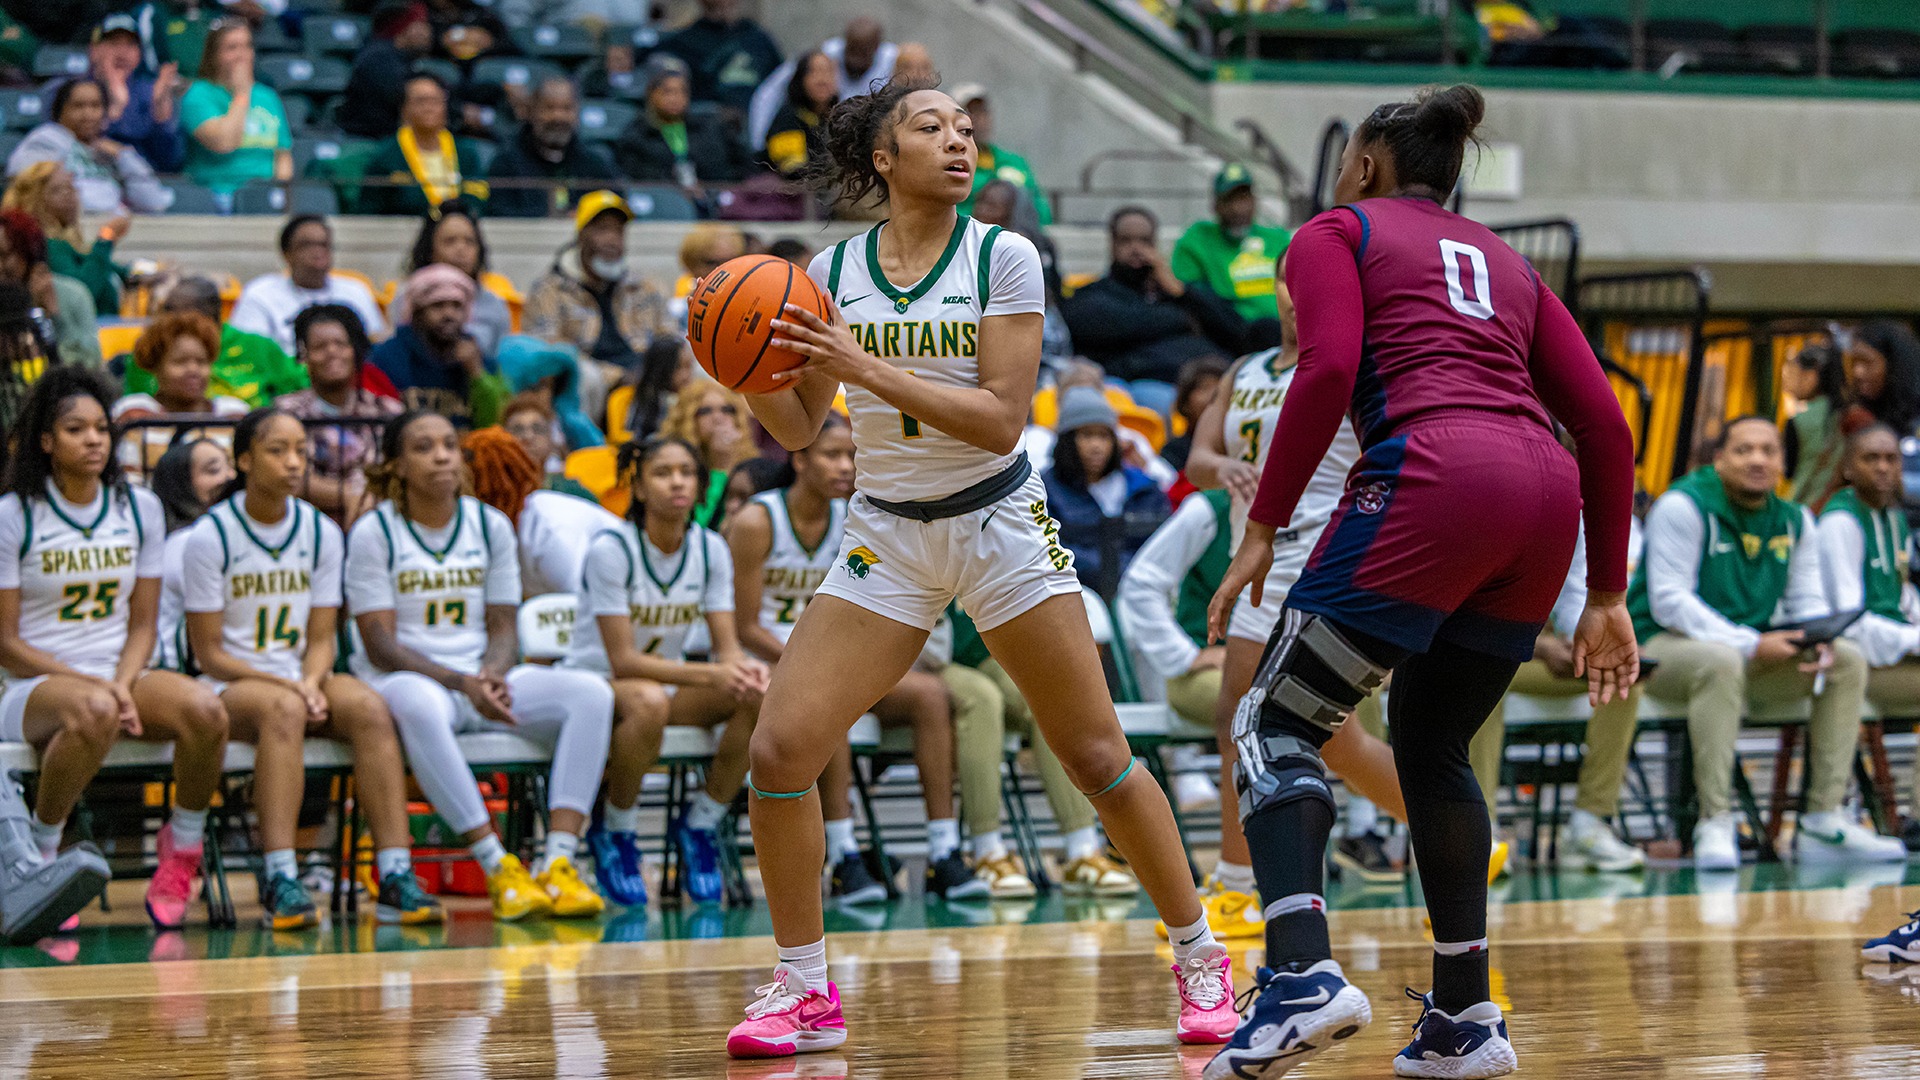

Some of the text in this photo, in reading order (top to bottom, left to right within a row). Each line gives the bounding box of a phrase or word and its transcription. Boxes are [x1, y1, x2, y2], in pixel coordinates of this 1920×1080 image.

[941, 296, 972, 305] MEAC
[1438, 238, 1495, 320] 0
[691, 269, 731, 344] ELITE
[850, 321, 977, 358] PARTANS
[59, 577, 120, 622] 25
[231, 570, 311, 599] SPARTAN
[254, 604, 300, 652] 14
